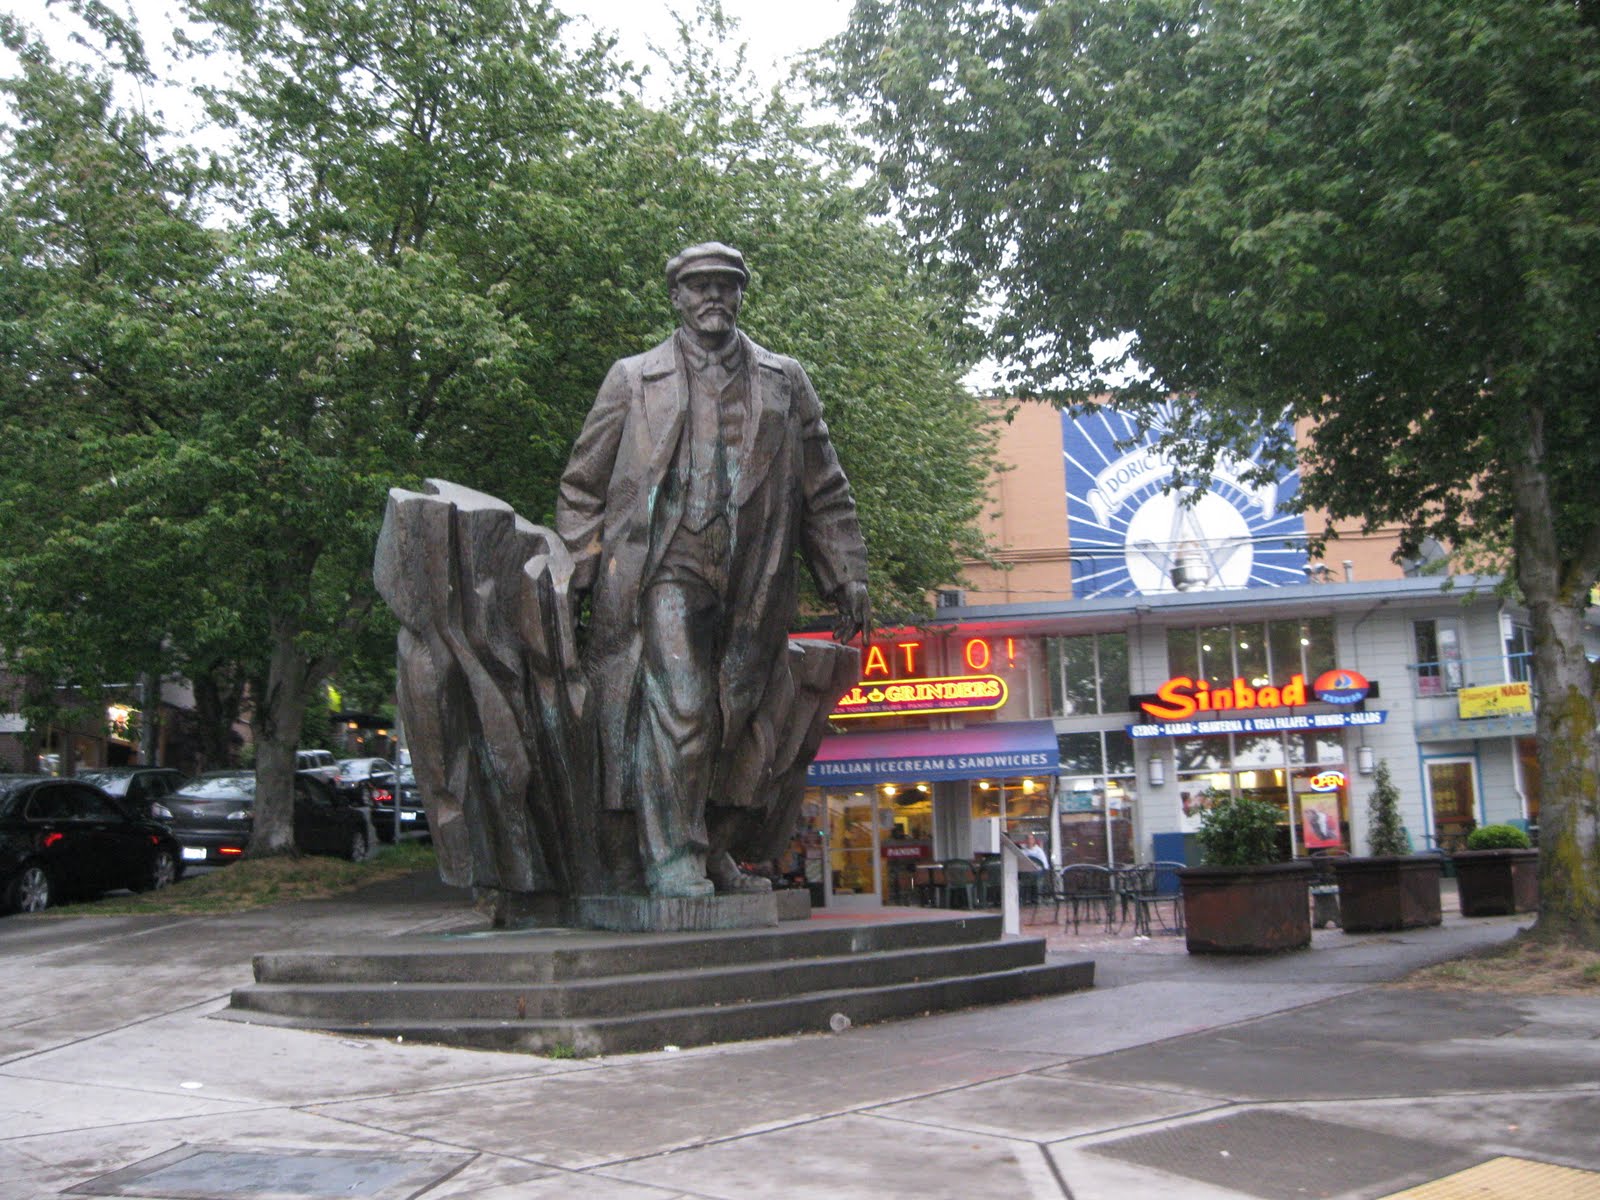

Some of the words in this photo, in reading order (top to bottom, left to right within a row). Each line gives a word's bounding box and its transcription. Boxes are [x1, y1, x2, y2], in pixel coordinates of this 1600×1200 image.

[1105, 455, 1154, 493] DORIC
[885, 681, 1000, 703] GRINDERS
[1141, 674, 1307, 720] Sinbad
[1501, 684, 1527, 697] NAILS
[820, 762, 871, 775] ITALIAN
[875, 759, 945, 773] ICECREAM
[947, 758, 956, 769] &
[959, 753, 1049, 769] SANDWICHES
[1310, 775, 1344, 787] OPEN
